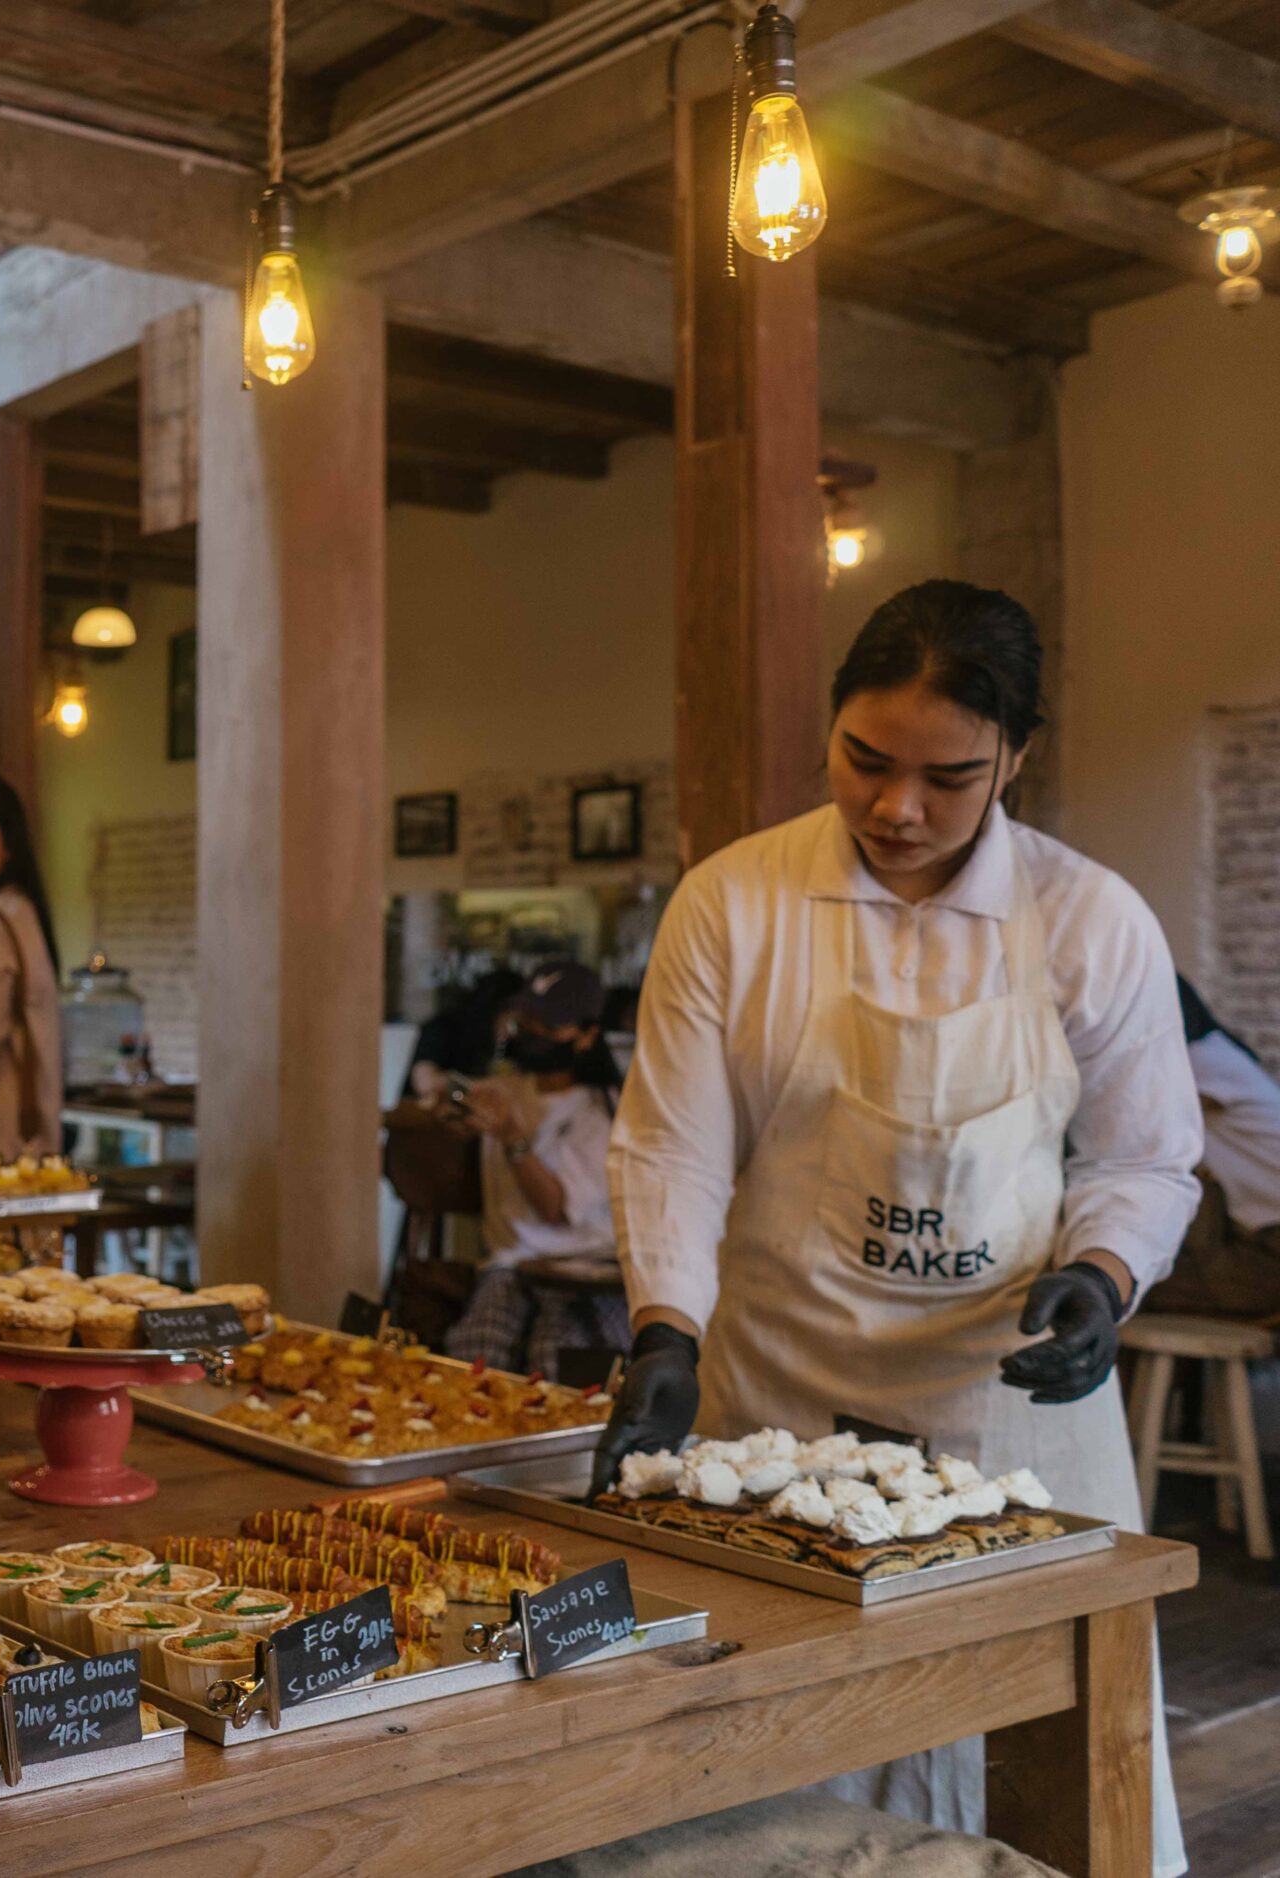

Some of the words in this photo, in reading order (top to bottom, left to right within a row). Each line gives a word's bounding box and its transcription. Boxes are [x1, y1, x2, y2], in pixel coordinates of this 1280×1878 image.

[865, 1196, 944, 1238] SBR
[863, 1238, 996, 1278] BAKER
[529, 1580, 610, 1629] Sausage
[303, 1612, 362, 1652] EGG
[546, 1618, 602, 1657] Scones
[83, 1657, 137, 1681] Black
[319, 1646, 339, 1662] in
[287, 1653, 361, 1700] Scones
